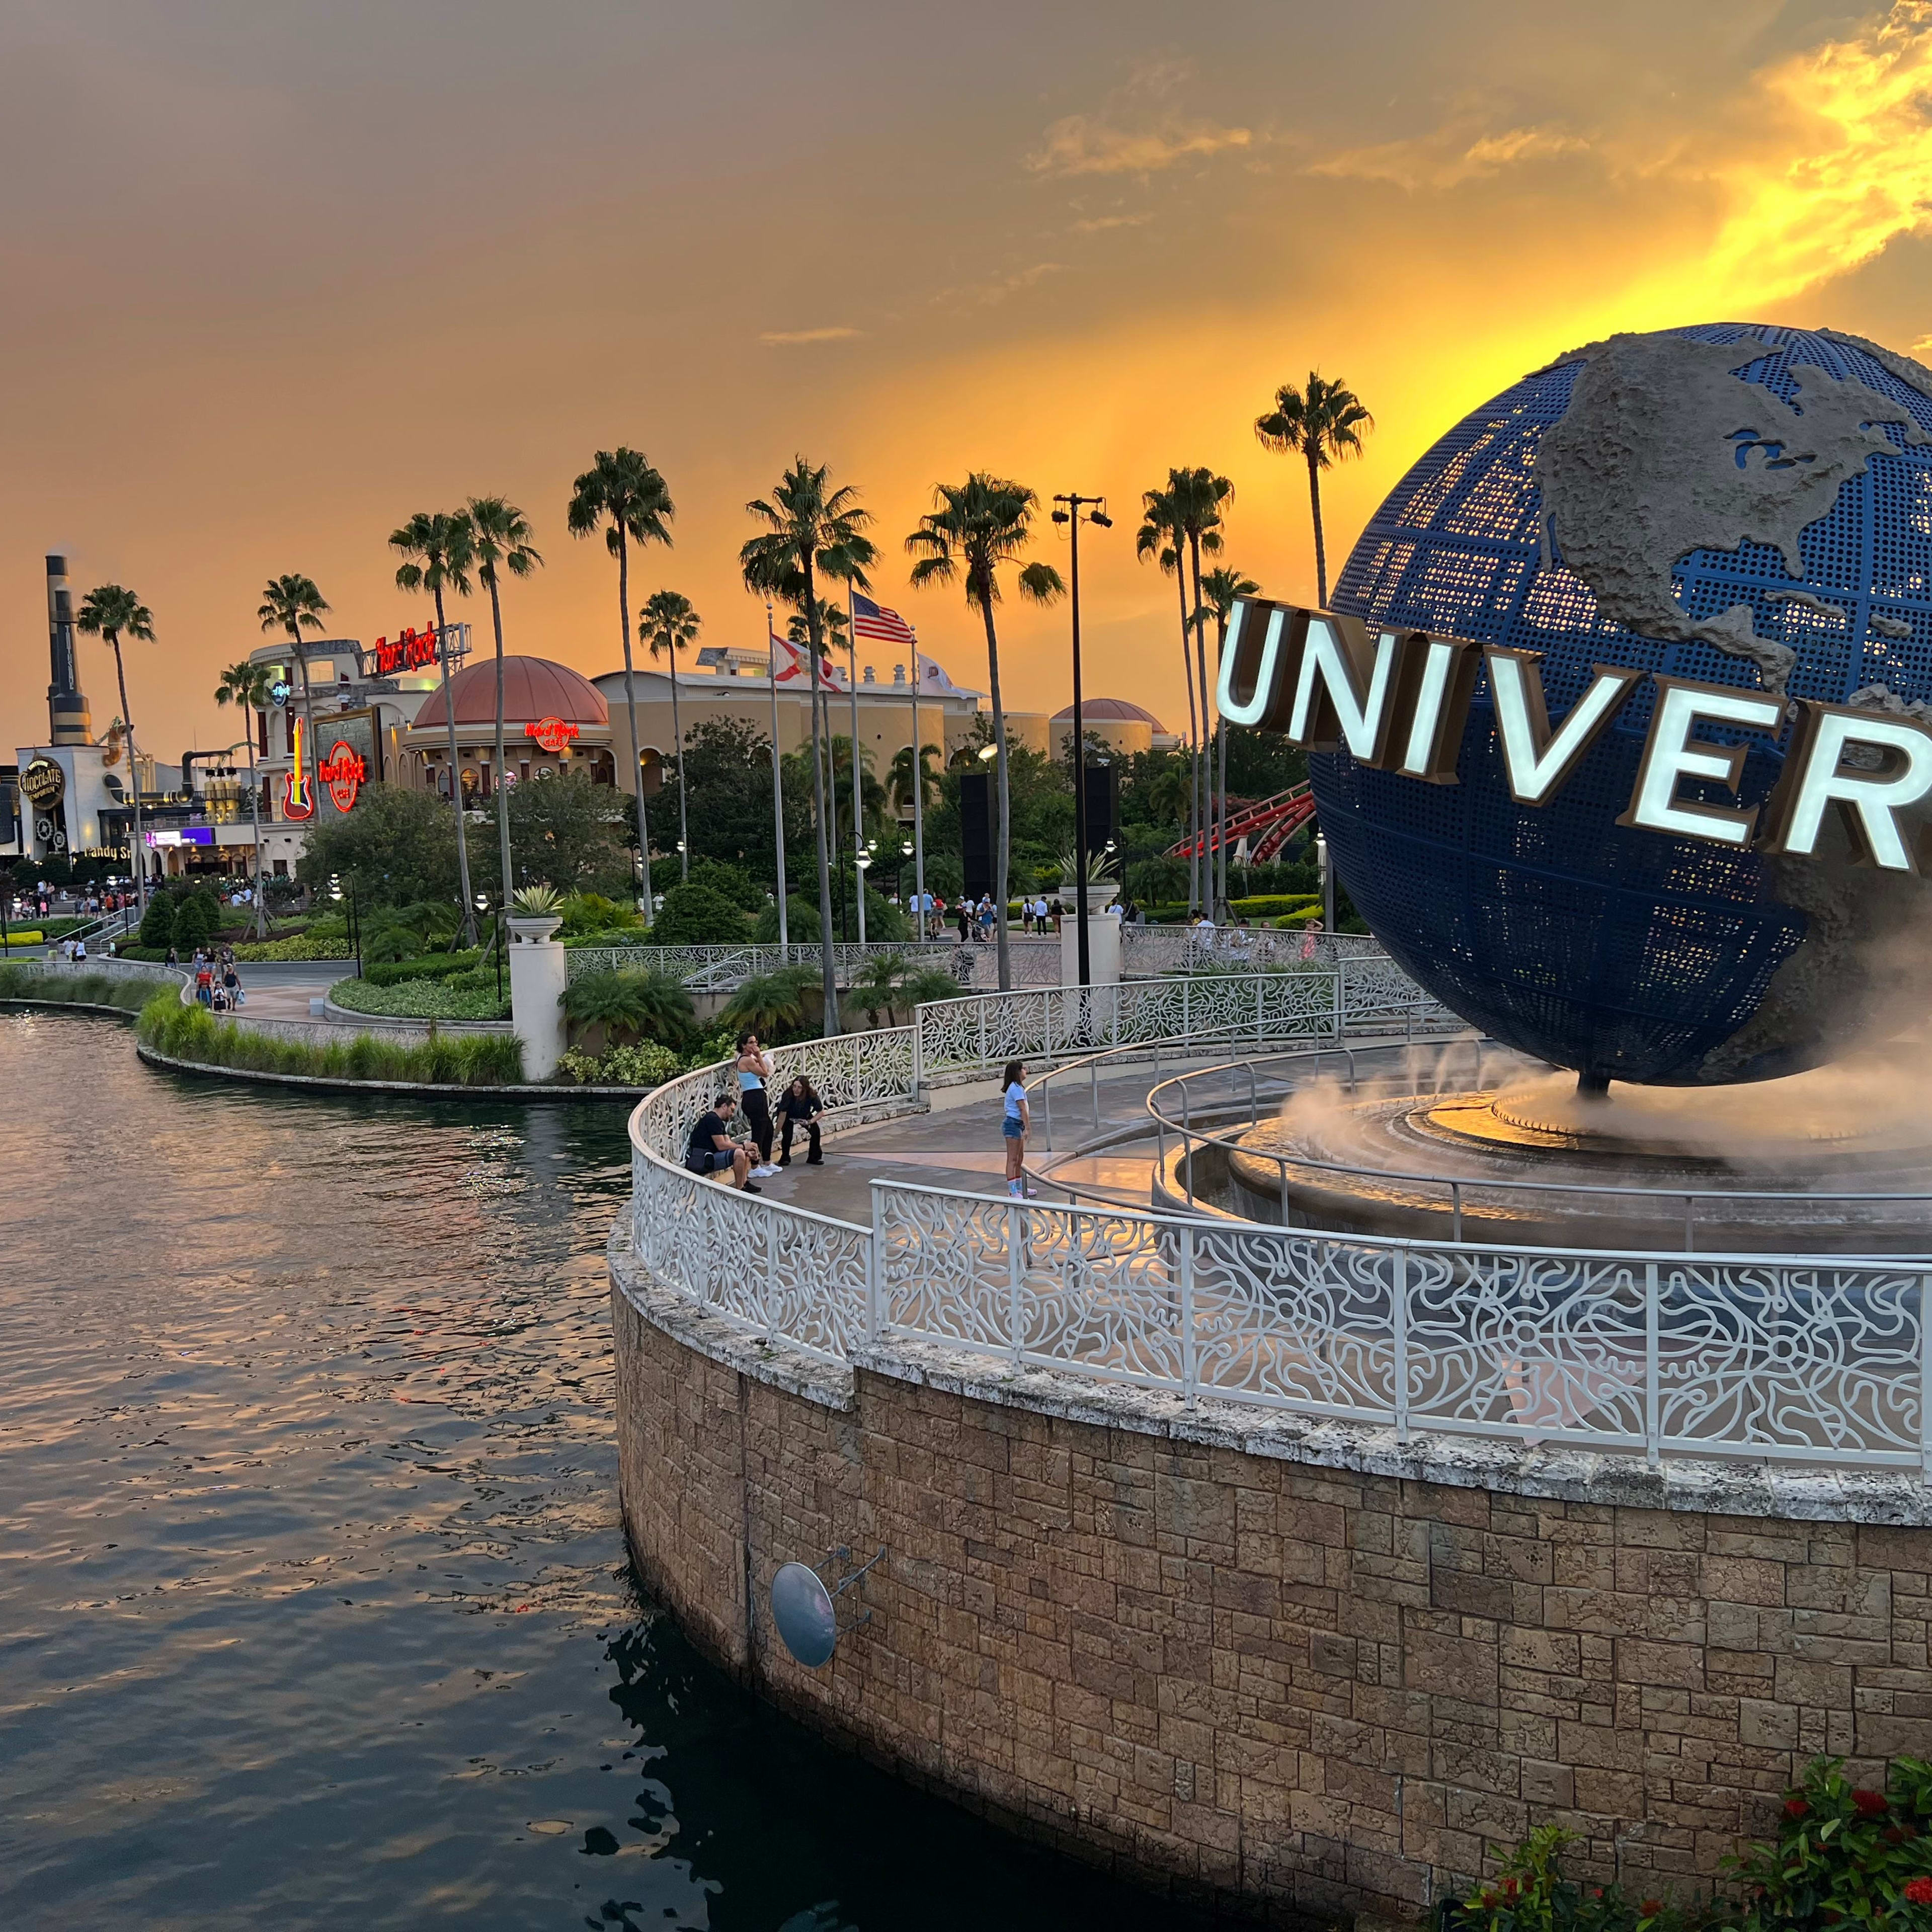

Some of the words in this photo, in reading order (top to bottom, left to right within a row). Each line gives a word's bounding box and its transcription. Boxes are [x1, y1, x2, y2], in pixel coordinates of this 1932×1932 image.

[376, 630, 405, 673] Hard
[406, 621, 437, 672] Rock
[525, 722, 552, 736] Hard
[553, 722, 580, 739] Rock
[1217, 598, 1932, 871] UNIVER
[18, 768, 61, 795] CHOCOLATE
[319, 757, 341, 781] Hard
[342, 755, 365, 785] Rock
[85, 845, 117, 860] Candy
